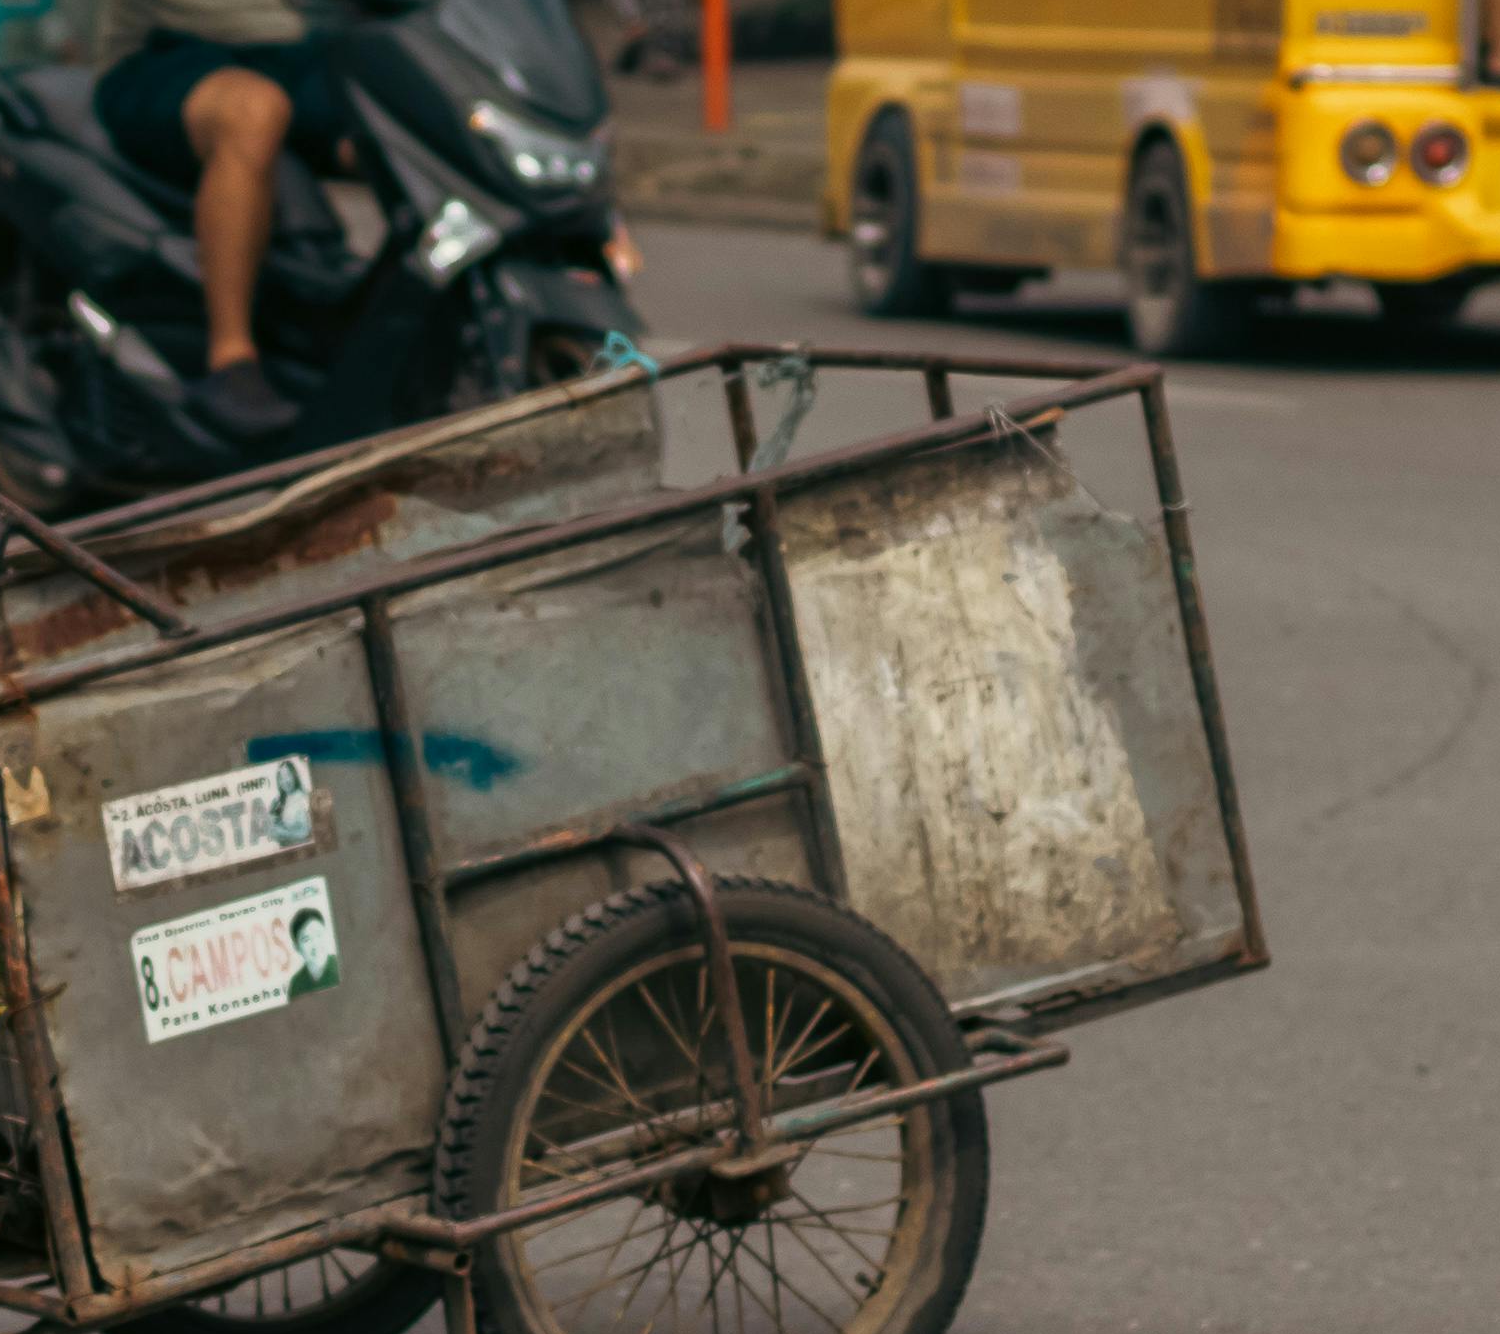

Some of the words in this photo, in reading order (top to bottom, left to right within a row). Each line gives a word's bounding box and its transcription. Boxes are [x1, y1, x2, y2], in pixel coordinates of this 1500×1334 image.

[195, 787, 229, 805] LUNA
[121, 797, 277, 874] ACOSTA
[136, 932, 160, 946] 2nd
[219, 904, 257, 923] Davao
[261, 896, 285, 910] City
[167, 917, 292, 1004] CAMPOS
[161, 1011, 200, 1029] Para
